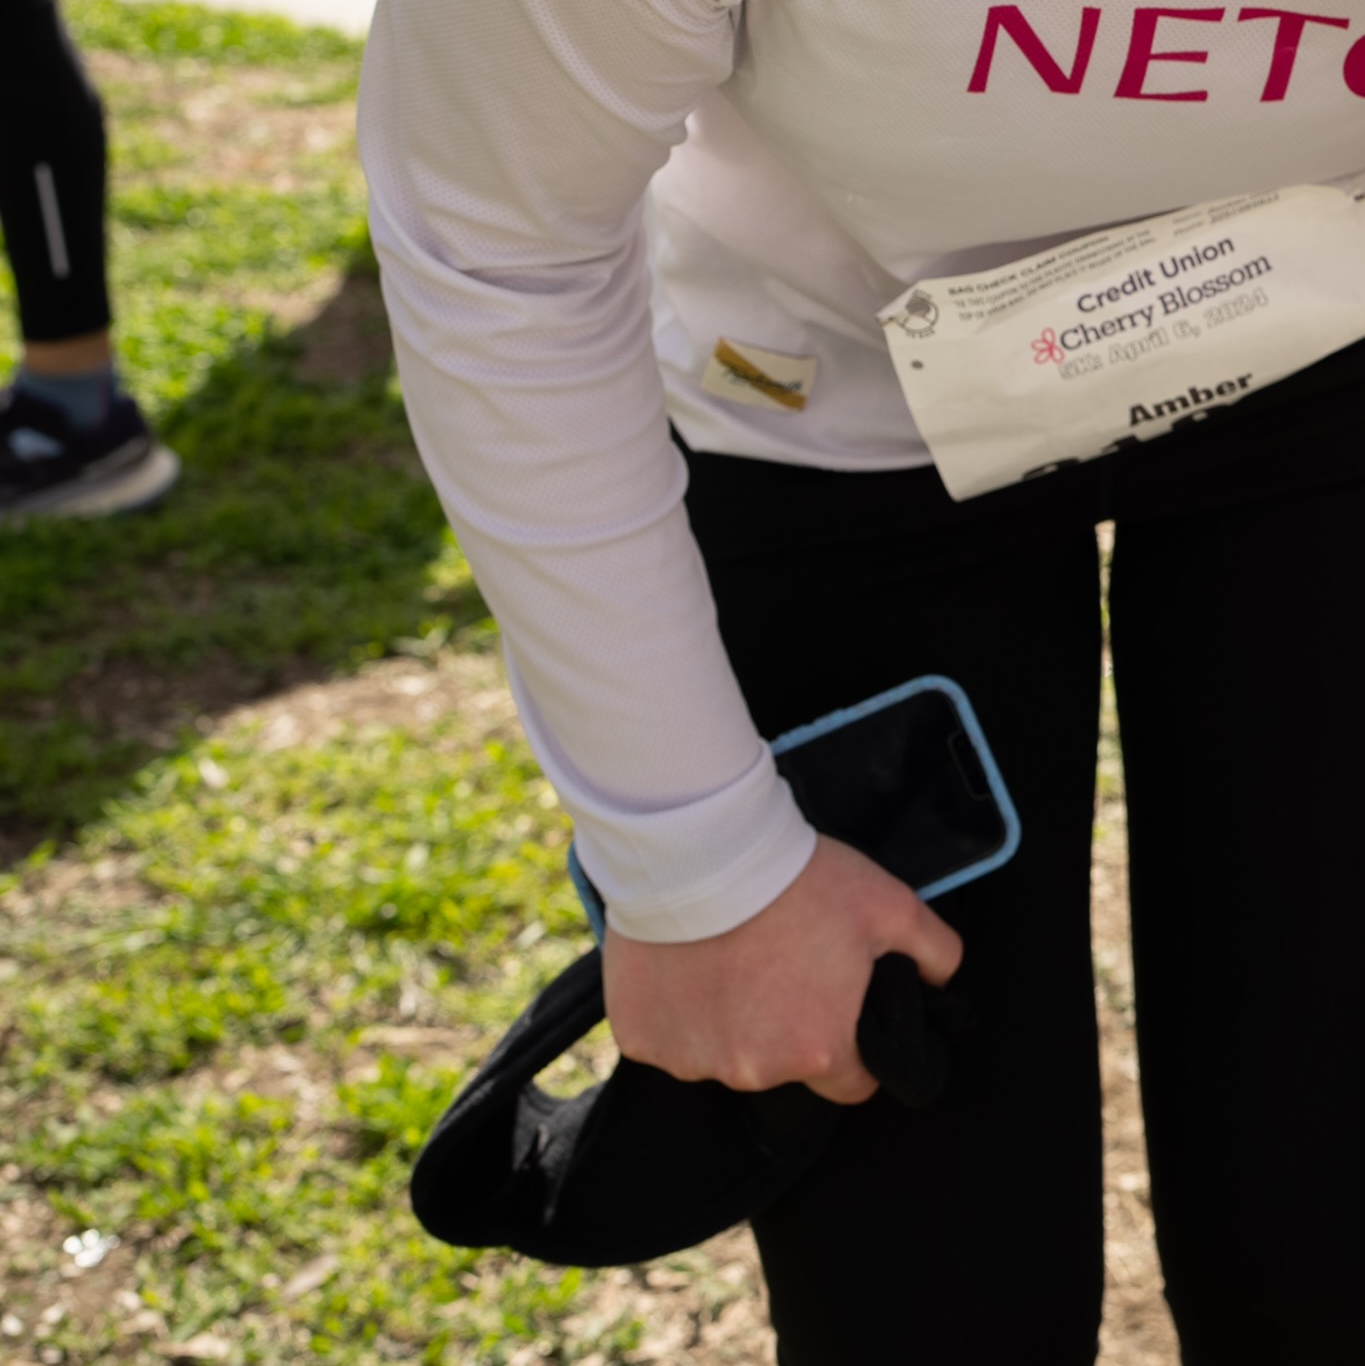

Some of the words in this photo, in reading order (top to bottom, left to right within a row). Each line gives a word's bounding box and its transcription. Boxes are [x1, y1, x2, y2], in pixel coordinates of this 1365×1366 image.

[1059, 305, 1154, 351] Cherry
[1158, 254, 1273, 316] Blossom
[1077, 269, 1156, 313] Credit
[1159, 236, 1235, 279] Union
[1107, 324, 1170, 366] April
[1128, 372, 1254, 428] Amber
